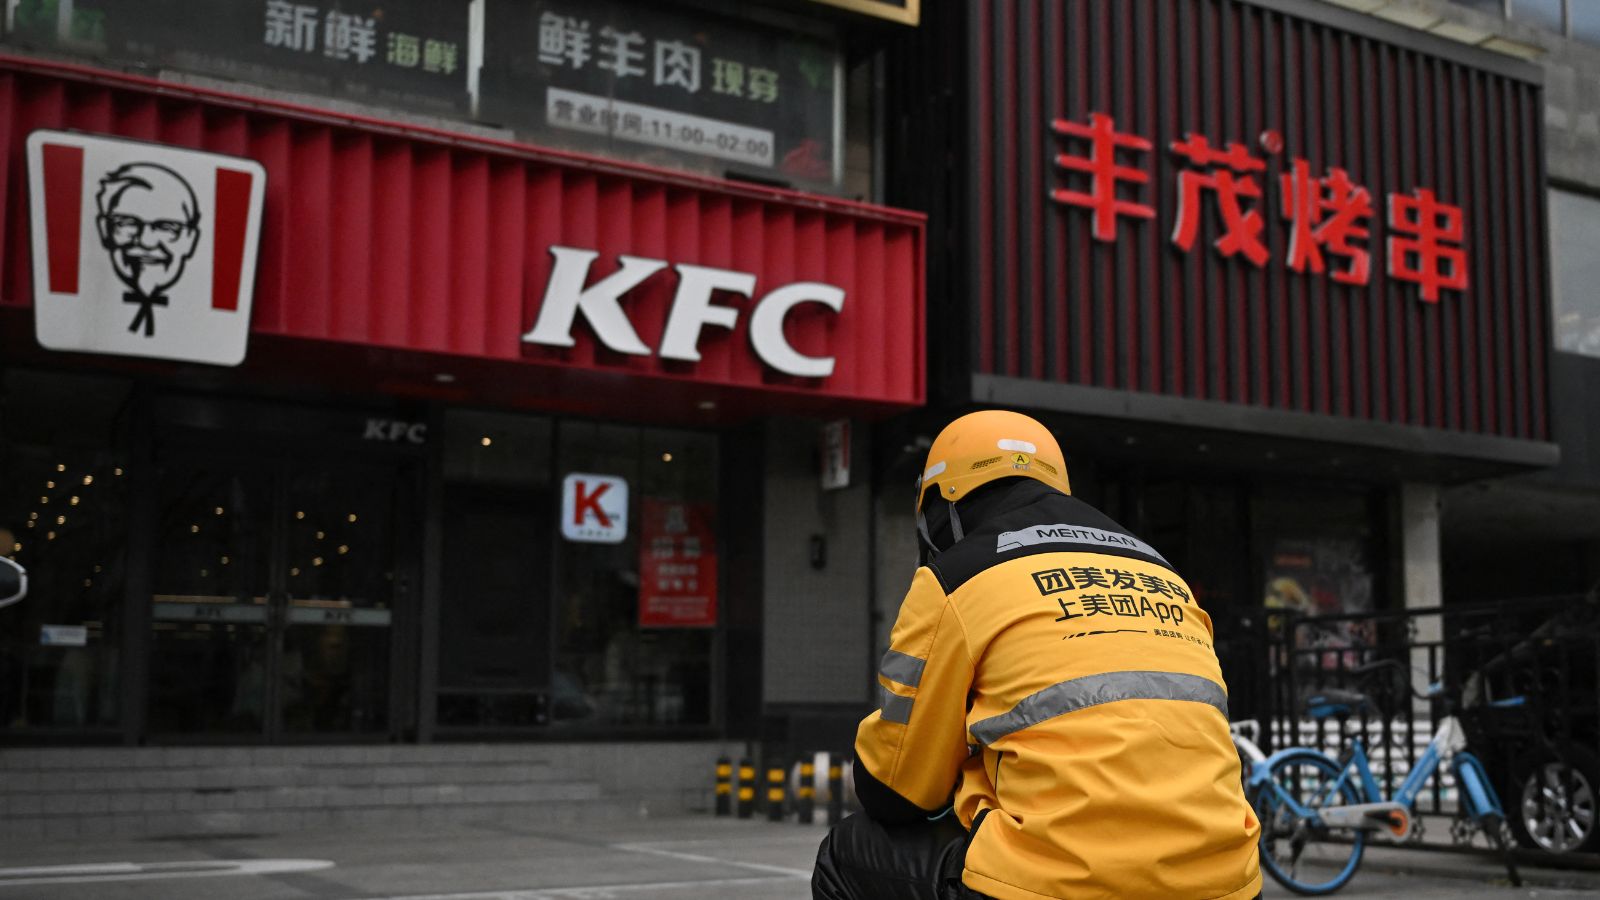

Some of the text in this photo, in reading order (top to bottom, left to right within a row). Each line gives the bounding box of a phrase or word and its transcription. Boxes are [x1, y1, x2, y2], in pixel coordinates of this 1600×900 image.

[538, 11, 701, 93] 鲜羊肉
[1051, 112, 1469, 303] 丰茂烤串
[522, 245, 845, 377] KFC
[363, 419, 427, 444] KFC
[1016, 454, 1025, 463] A
[576, 481, 614, 529] K
[1036, 528, 1138, 548] MEITUAN
[1031, 566, 1190, 604] 团美发美甲
